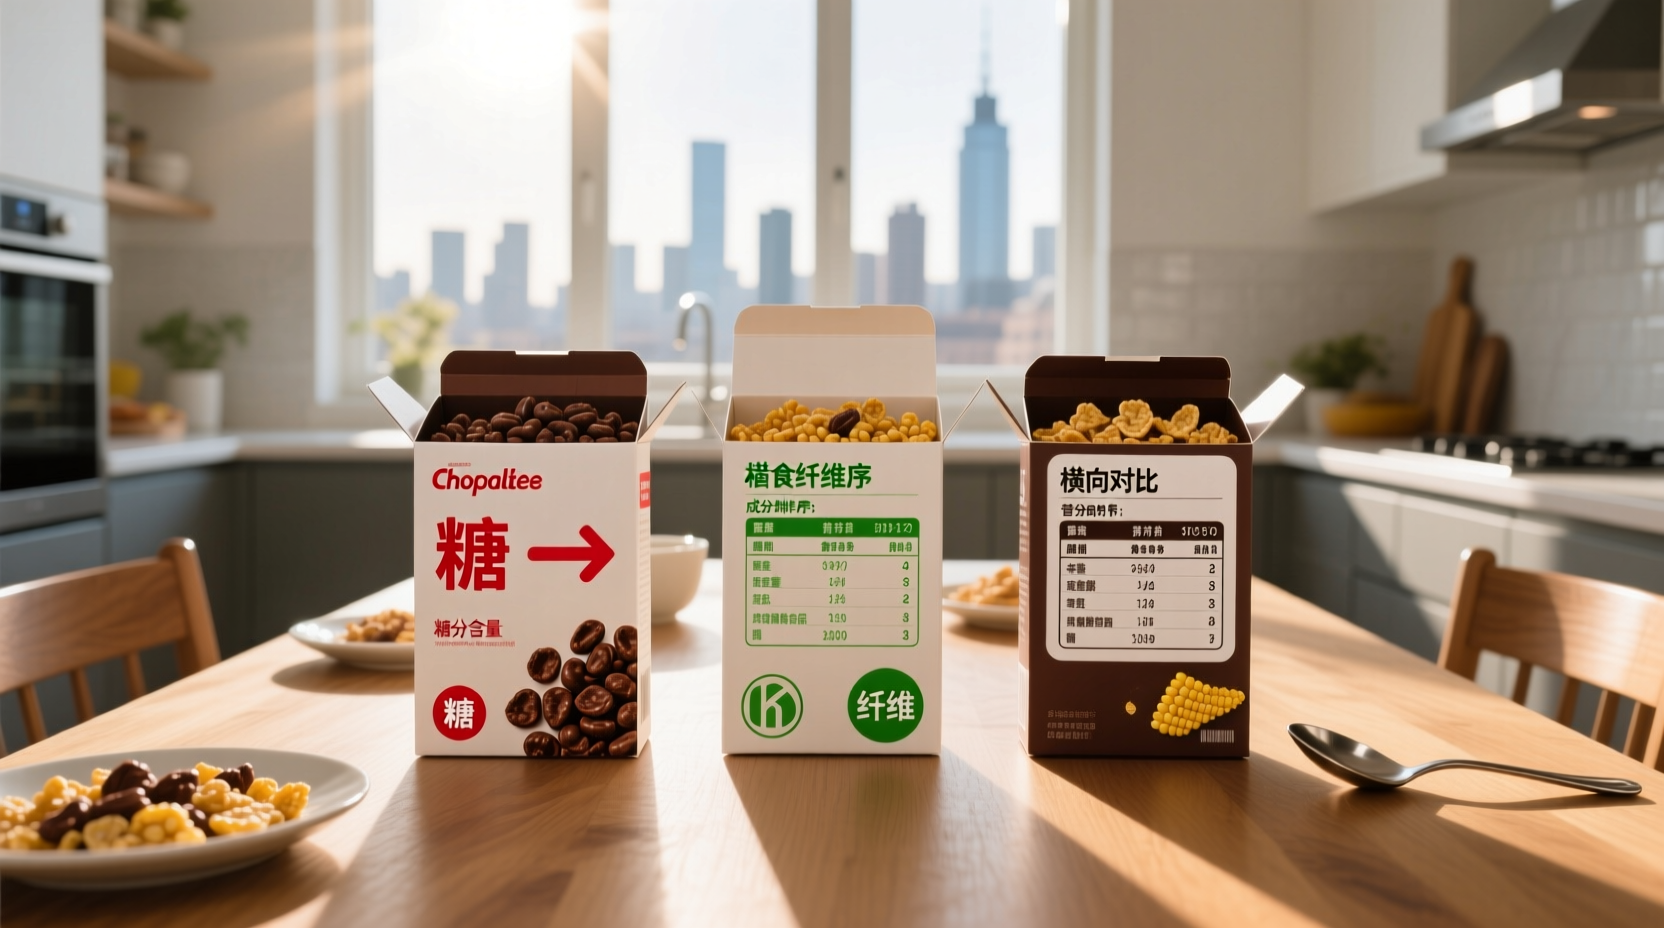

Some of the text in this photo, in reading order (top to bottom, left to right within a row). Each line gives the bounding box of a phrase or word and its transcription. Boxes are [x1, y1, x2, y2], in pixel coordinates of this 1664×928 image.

[1060, 466, 1159, 494] 横向对比
[435, 516, 510, 591] 糖
[434, 618, 503, 638] 糖分含量
[443, 697, 475, 729] 糖
[856, 690, 915, 722] 纤维
